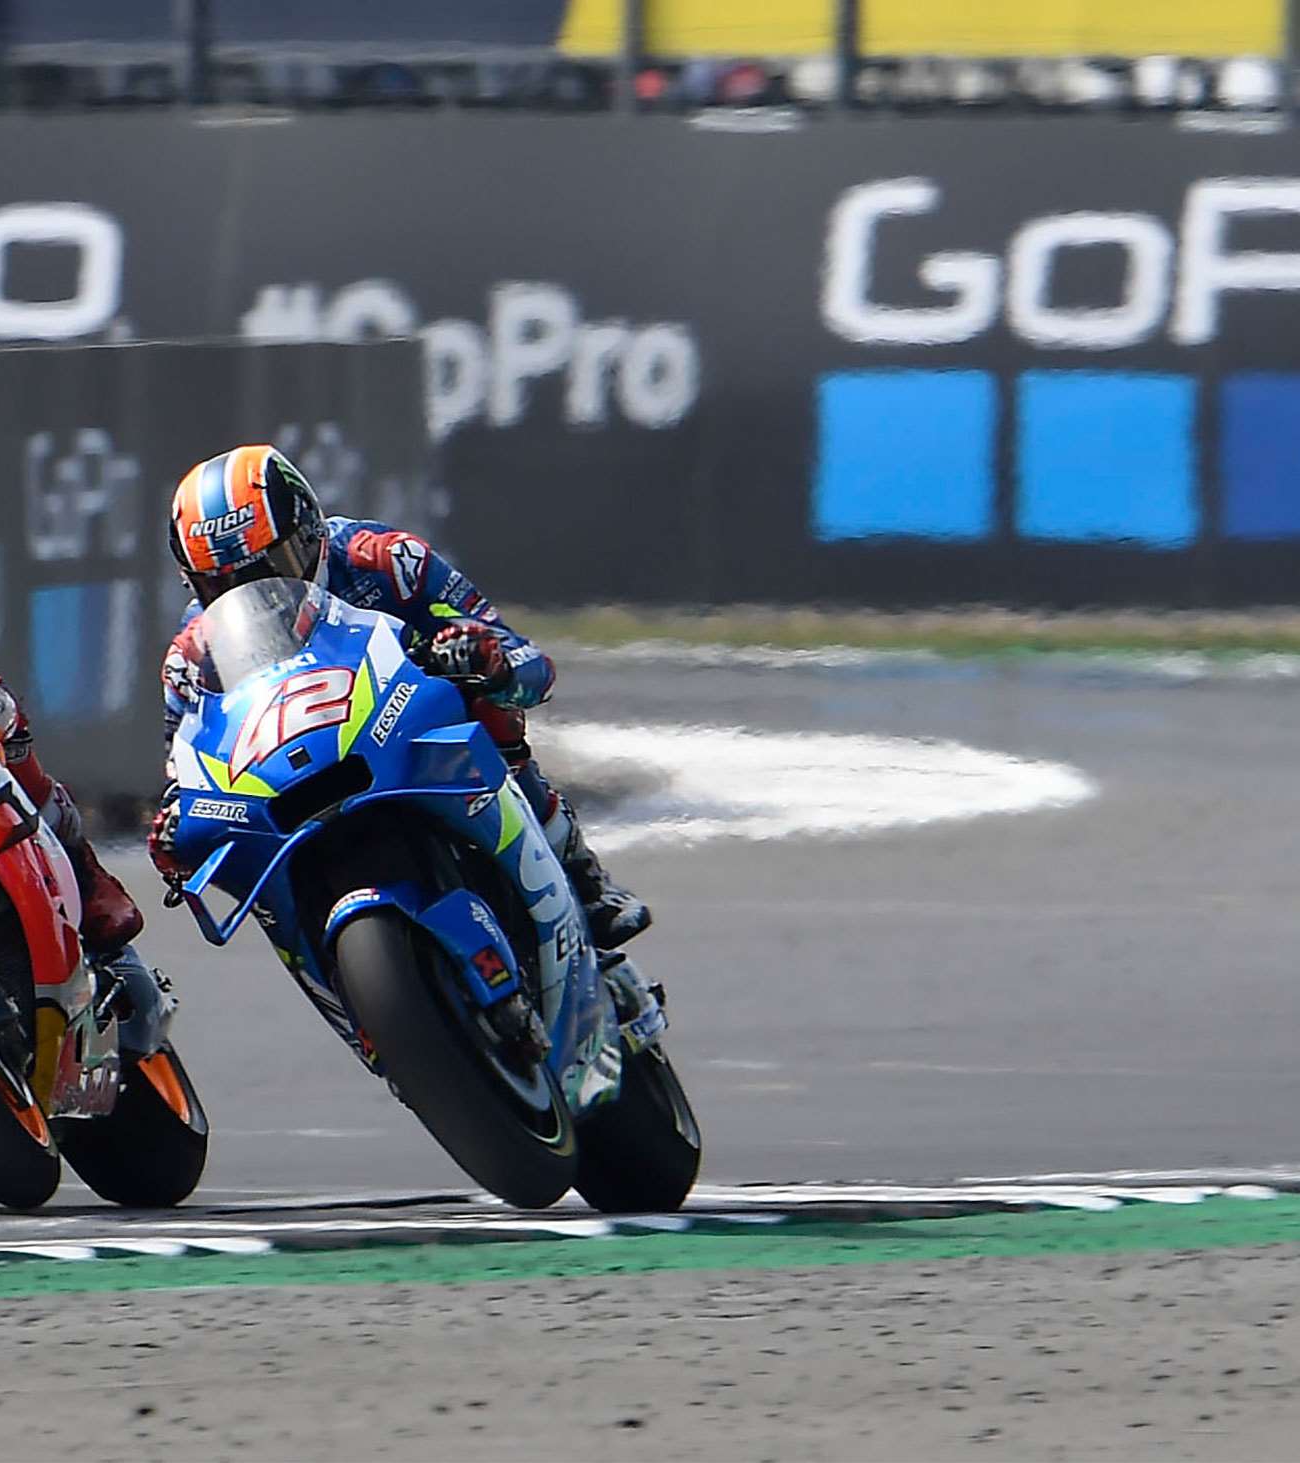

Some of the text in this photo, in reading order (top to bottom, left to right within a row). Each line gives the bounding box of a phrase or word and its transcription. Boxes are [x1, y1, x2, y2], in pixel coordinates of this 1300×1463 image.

[189, 503, 254, 538] NOLAN
[228, 665, 357, 788] 42
[372, 683, 417, 747] ECSTAR
